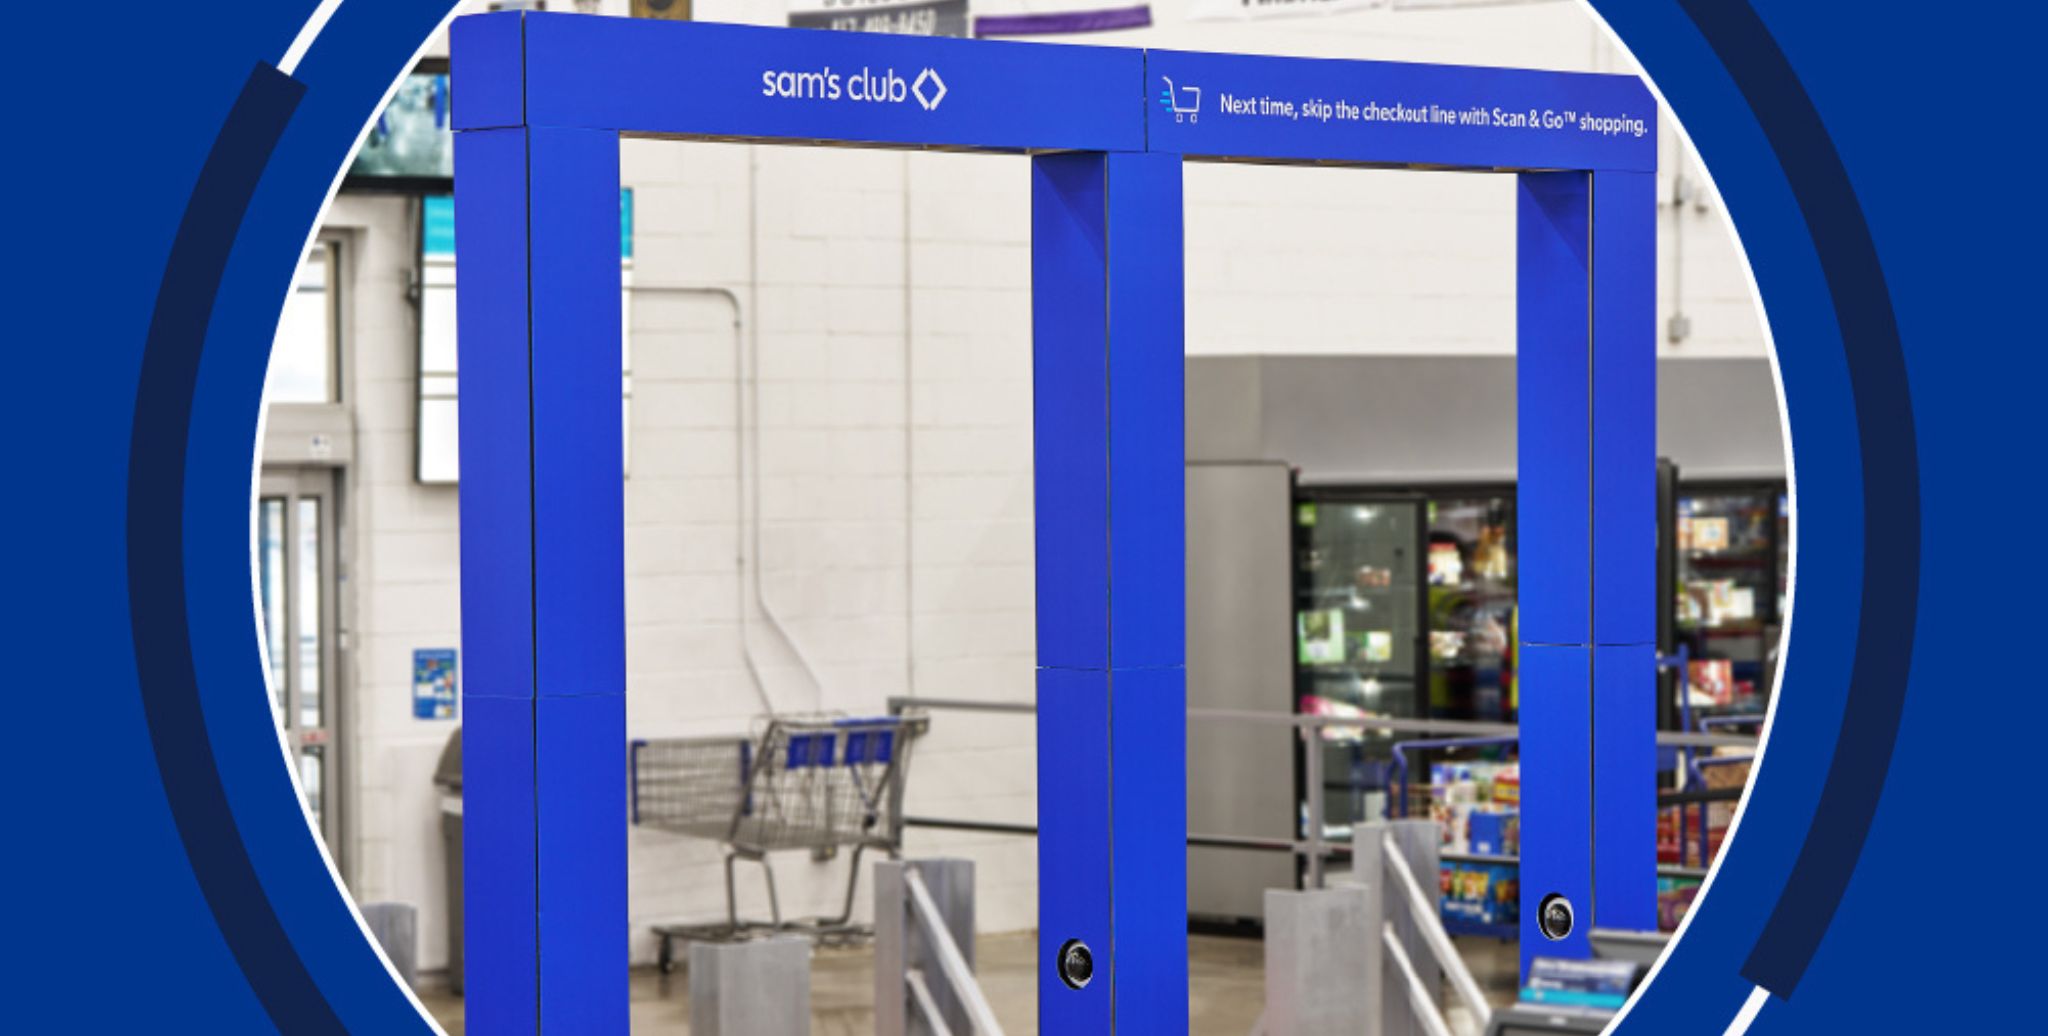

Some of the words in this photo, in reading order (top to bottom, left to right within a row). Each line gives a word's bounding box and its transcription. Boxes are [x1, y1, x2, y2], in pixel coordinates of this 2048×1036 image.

[763, 66, 841, 100] sam's
[847, 66, 907, 102] club
[1220, 93, 1256, 115] Next
[1260, 96, 1298, 120] time,
[1302, 99, 1332, 123] skip
[1336, 100, 1359, 120] the
[1363, 102, 1428, 123] checkout
[1430, 105, 1456, 125] line
[1459, 107, 1491, 126] with
[1493, 107, 1526, 127] Scan
[1528, 109, 1540, 128] &
[1579, 113, 1648, 137] shopping.
